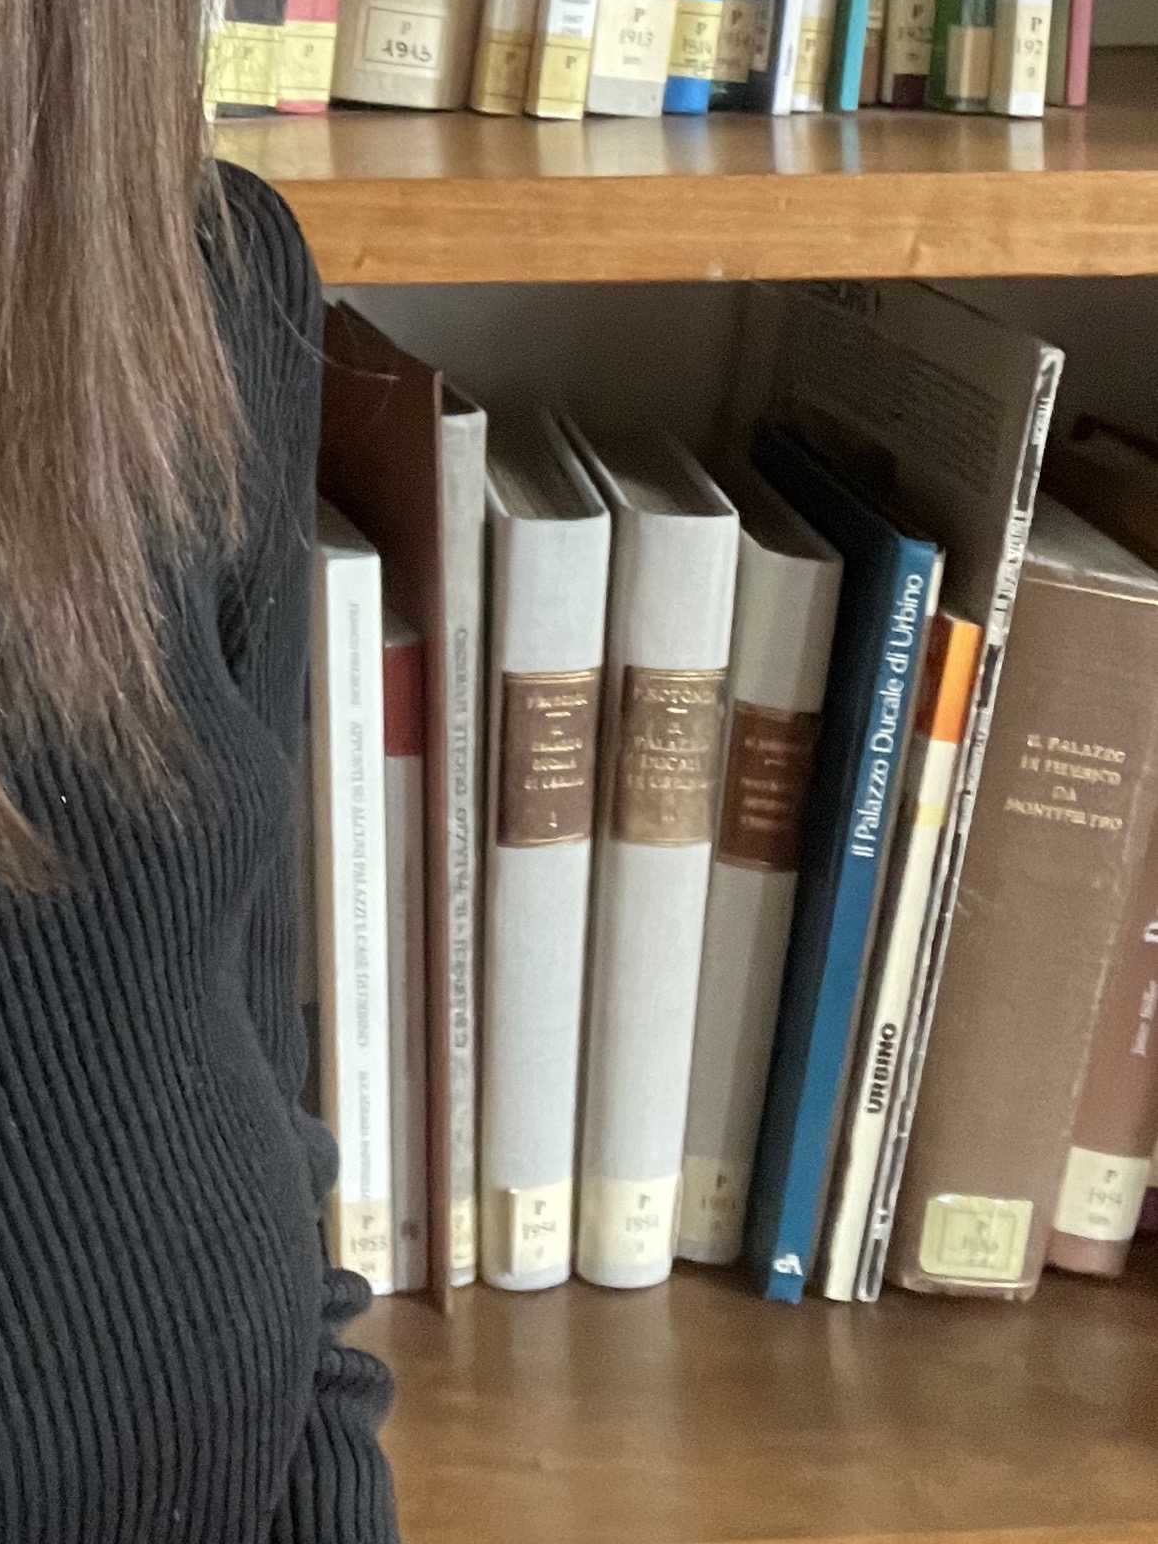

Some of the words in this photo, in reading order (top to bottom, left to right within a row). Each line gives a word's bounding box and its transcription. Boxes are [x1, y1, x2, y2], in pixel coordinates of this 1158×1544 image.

[401, 20, 413, 36] P
[1030, 16, 1043, 32] P
[888, 573, 925, 648] Urbino
[886, 652, 911, 673] di
[869, 677, 907, 755] Ducale
[854, 758, 891, 841] Palazzo
[850, 844, 876, 859] Il
[864, 1022, 897, 1115] URBINO
